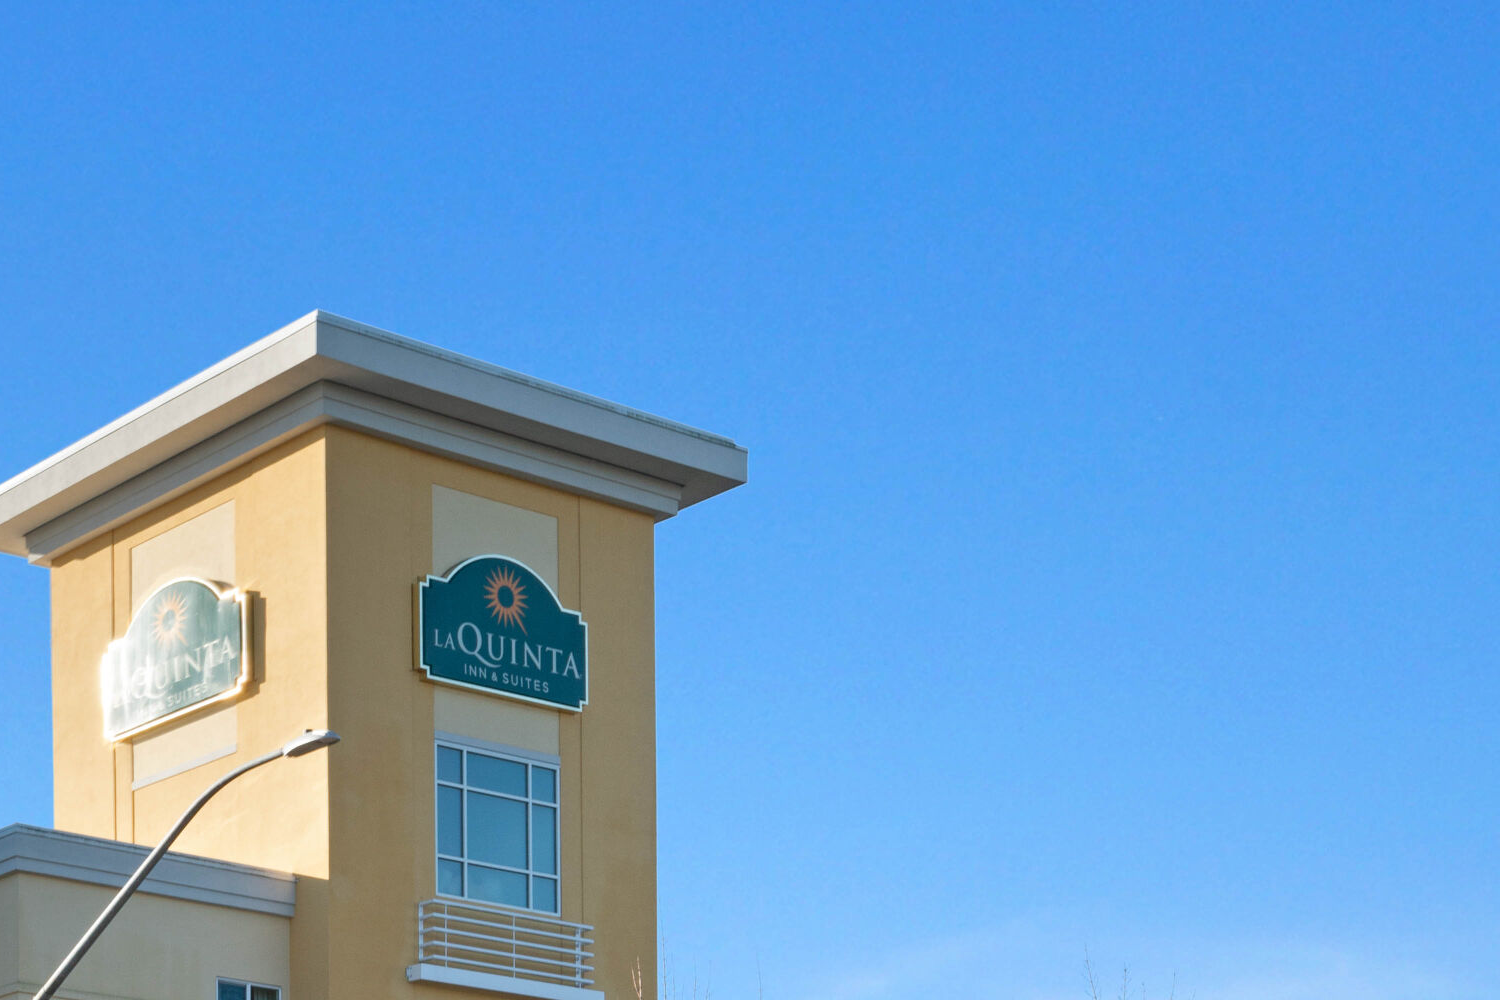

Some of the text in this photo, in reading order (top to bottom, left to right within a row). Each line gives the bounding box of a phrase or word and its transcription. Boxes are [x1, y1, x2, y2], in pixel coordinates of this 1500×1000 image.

[435, 622, 581, 679] LA QUINTA
[464, 664, 549, 693] INN & SUITES
